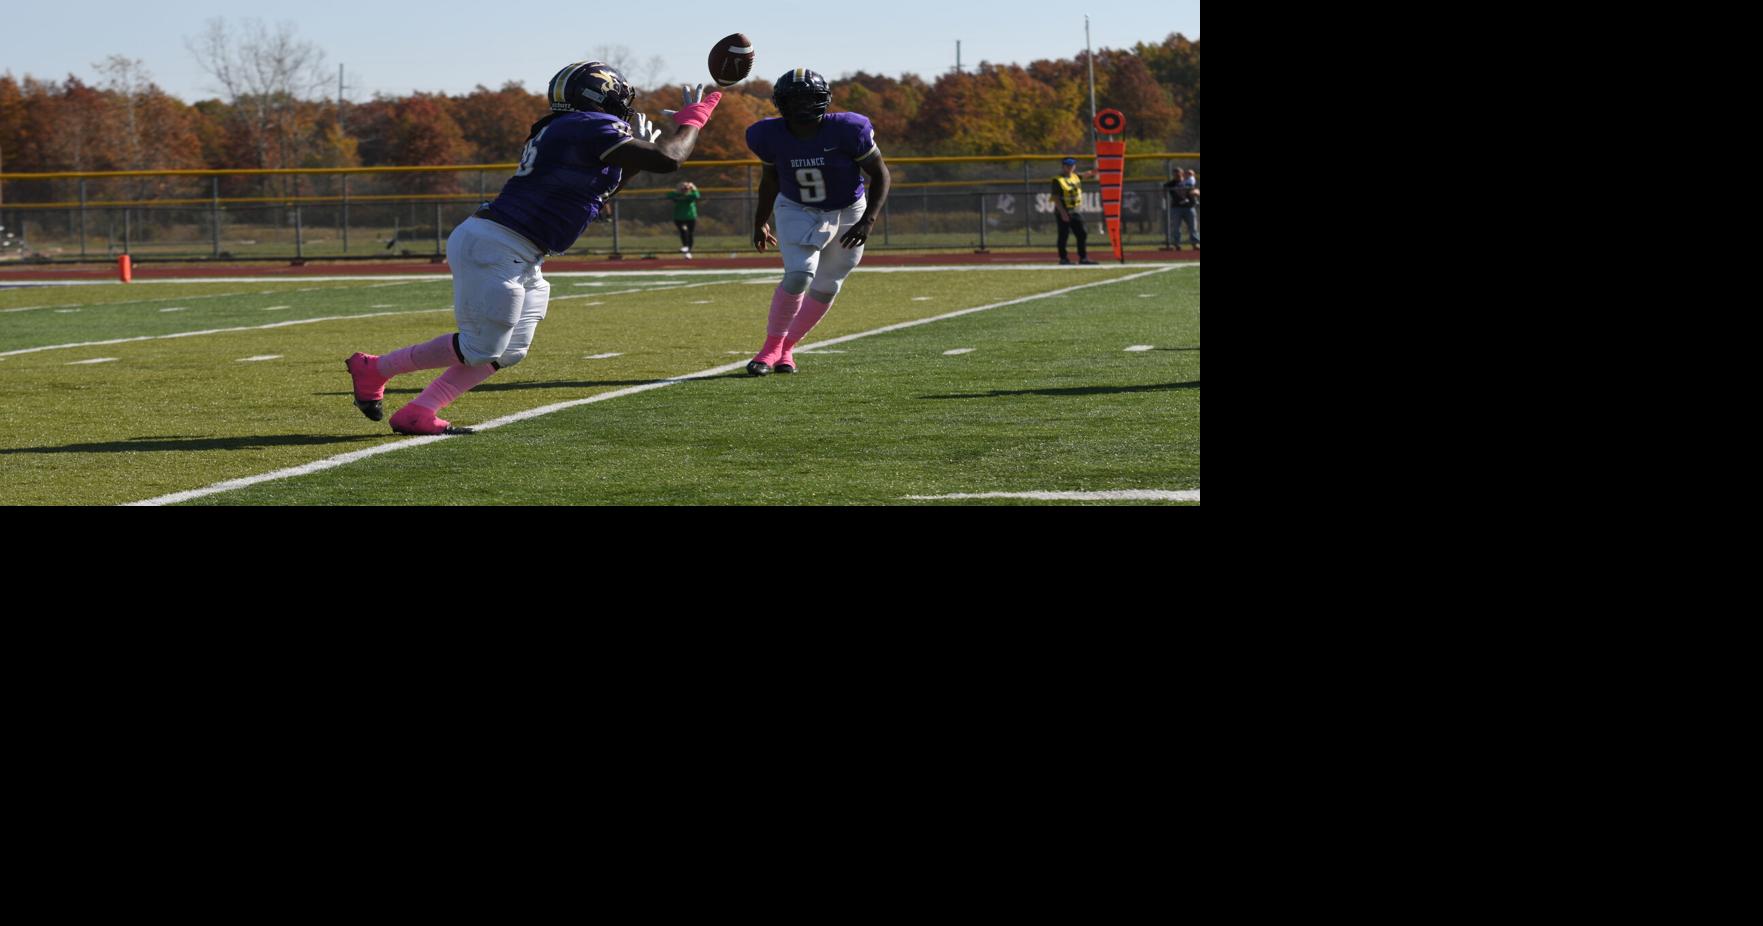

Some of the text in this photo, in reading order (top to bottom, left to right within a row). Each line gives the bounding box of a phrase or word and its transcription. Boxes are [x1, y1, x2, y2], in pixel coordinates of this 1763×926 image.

[790, 157, 825, 168] DEFIANCE
[795, 168, 827, 202] 9
[1035, 193, 1103, 213] SOALL
